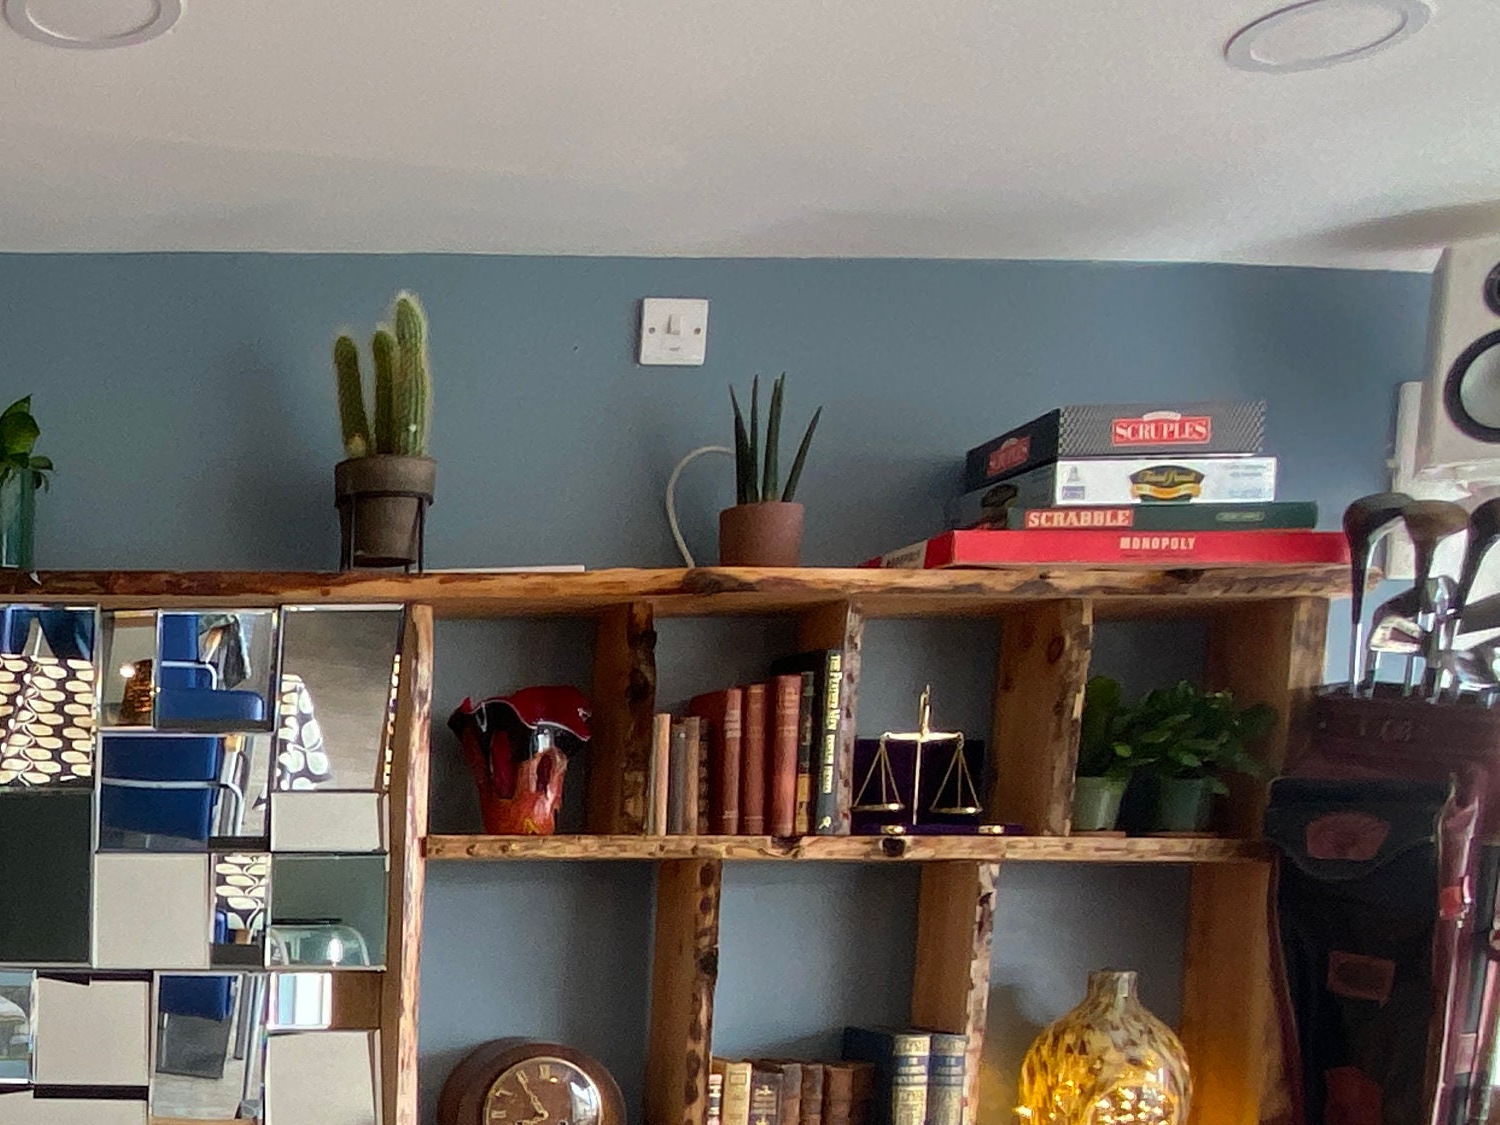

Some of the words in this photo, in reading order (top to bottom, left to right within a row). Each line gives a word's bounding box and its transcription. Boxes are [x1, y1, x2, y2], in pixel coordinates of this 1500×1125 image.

[1115, 419, 1208, 441] SCRUPLES
[1027, 509, 1131, 528] SCRABBLE
[1119, 536, 1196, 550] MONOPOLY
